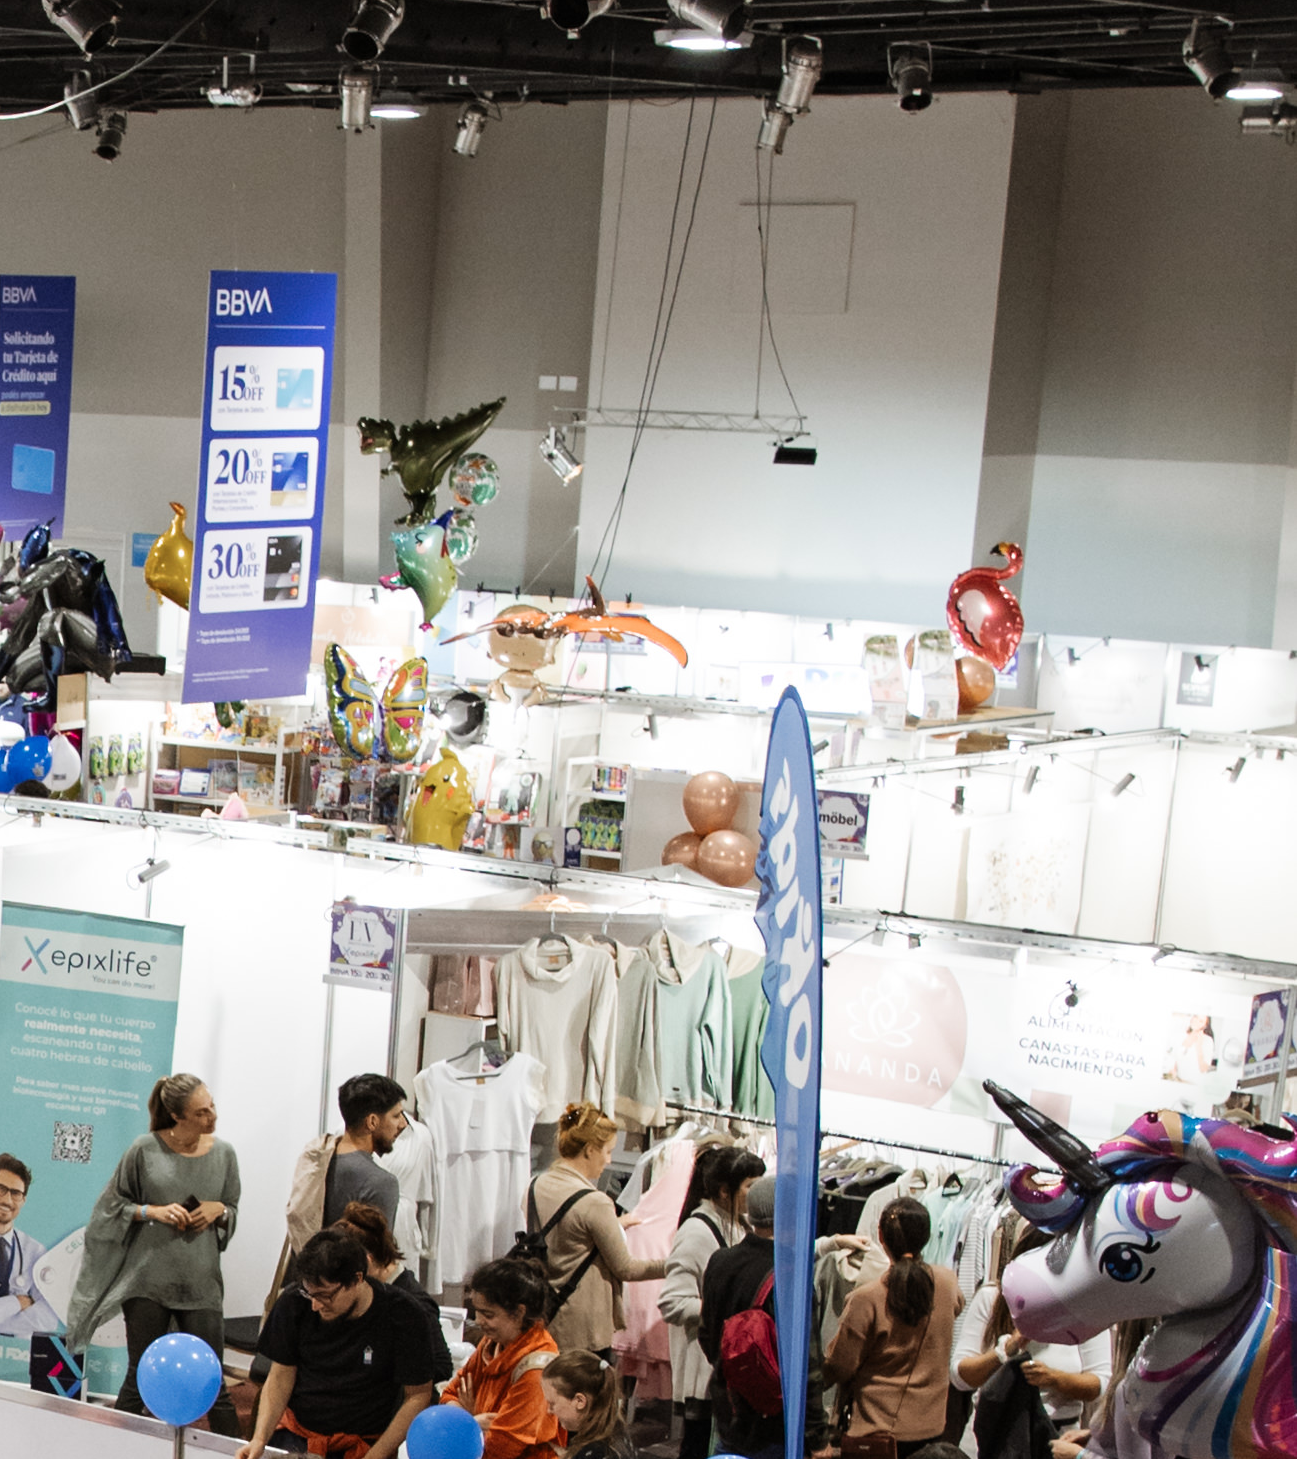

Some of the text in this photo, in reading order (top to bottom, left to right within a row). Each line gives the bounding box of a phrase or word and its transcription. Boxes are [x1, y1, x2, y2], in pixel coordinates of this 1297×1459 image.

[2, 287, 37, 304] BBVA
[216, 288, 272, 316] BBVA
[3, 332, 55, 345] Solicitando
[3, 351, 58, 365] tu Tarjeta de
[2, 369, 57, 385] Crédito aquí
[244, 387, 265, 401] OFF
[246, 470, 267, 485] OFF
[239, 563, 260, 578] OFF
[818, 810, 858, 827] möbel
[15, 1001, 156, 1031] Conocé lo que tu cuerpo
[24, 1018, 86, 1036] realmente
[22, 1033, 142, 1058] escaneando tan solo
[1018, 1037, 1145, 1068] CANASTAS PARA
[10, 1045, 152, 1073] cuatro hebras de cabello
[1027, 1053, 1133, 1081] NACIMIENTOS
